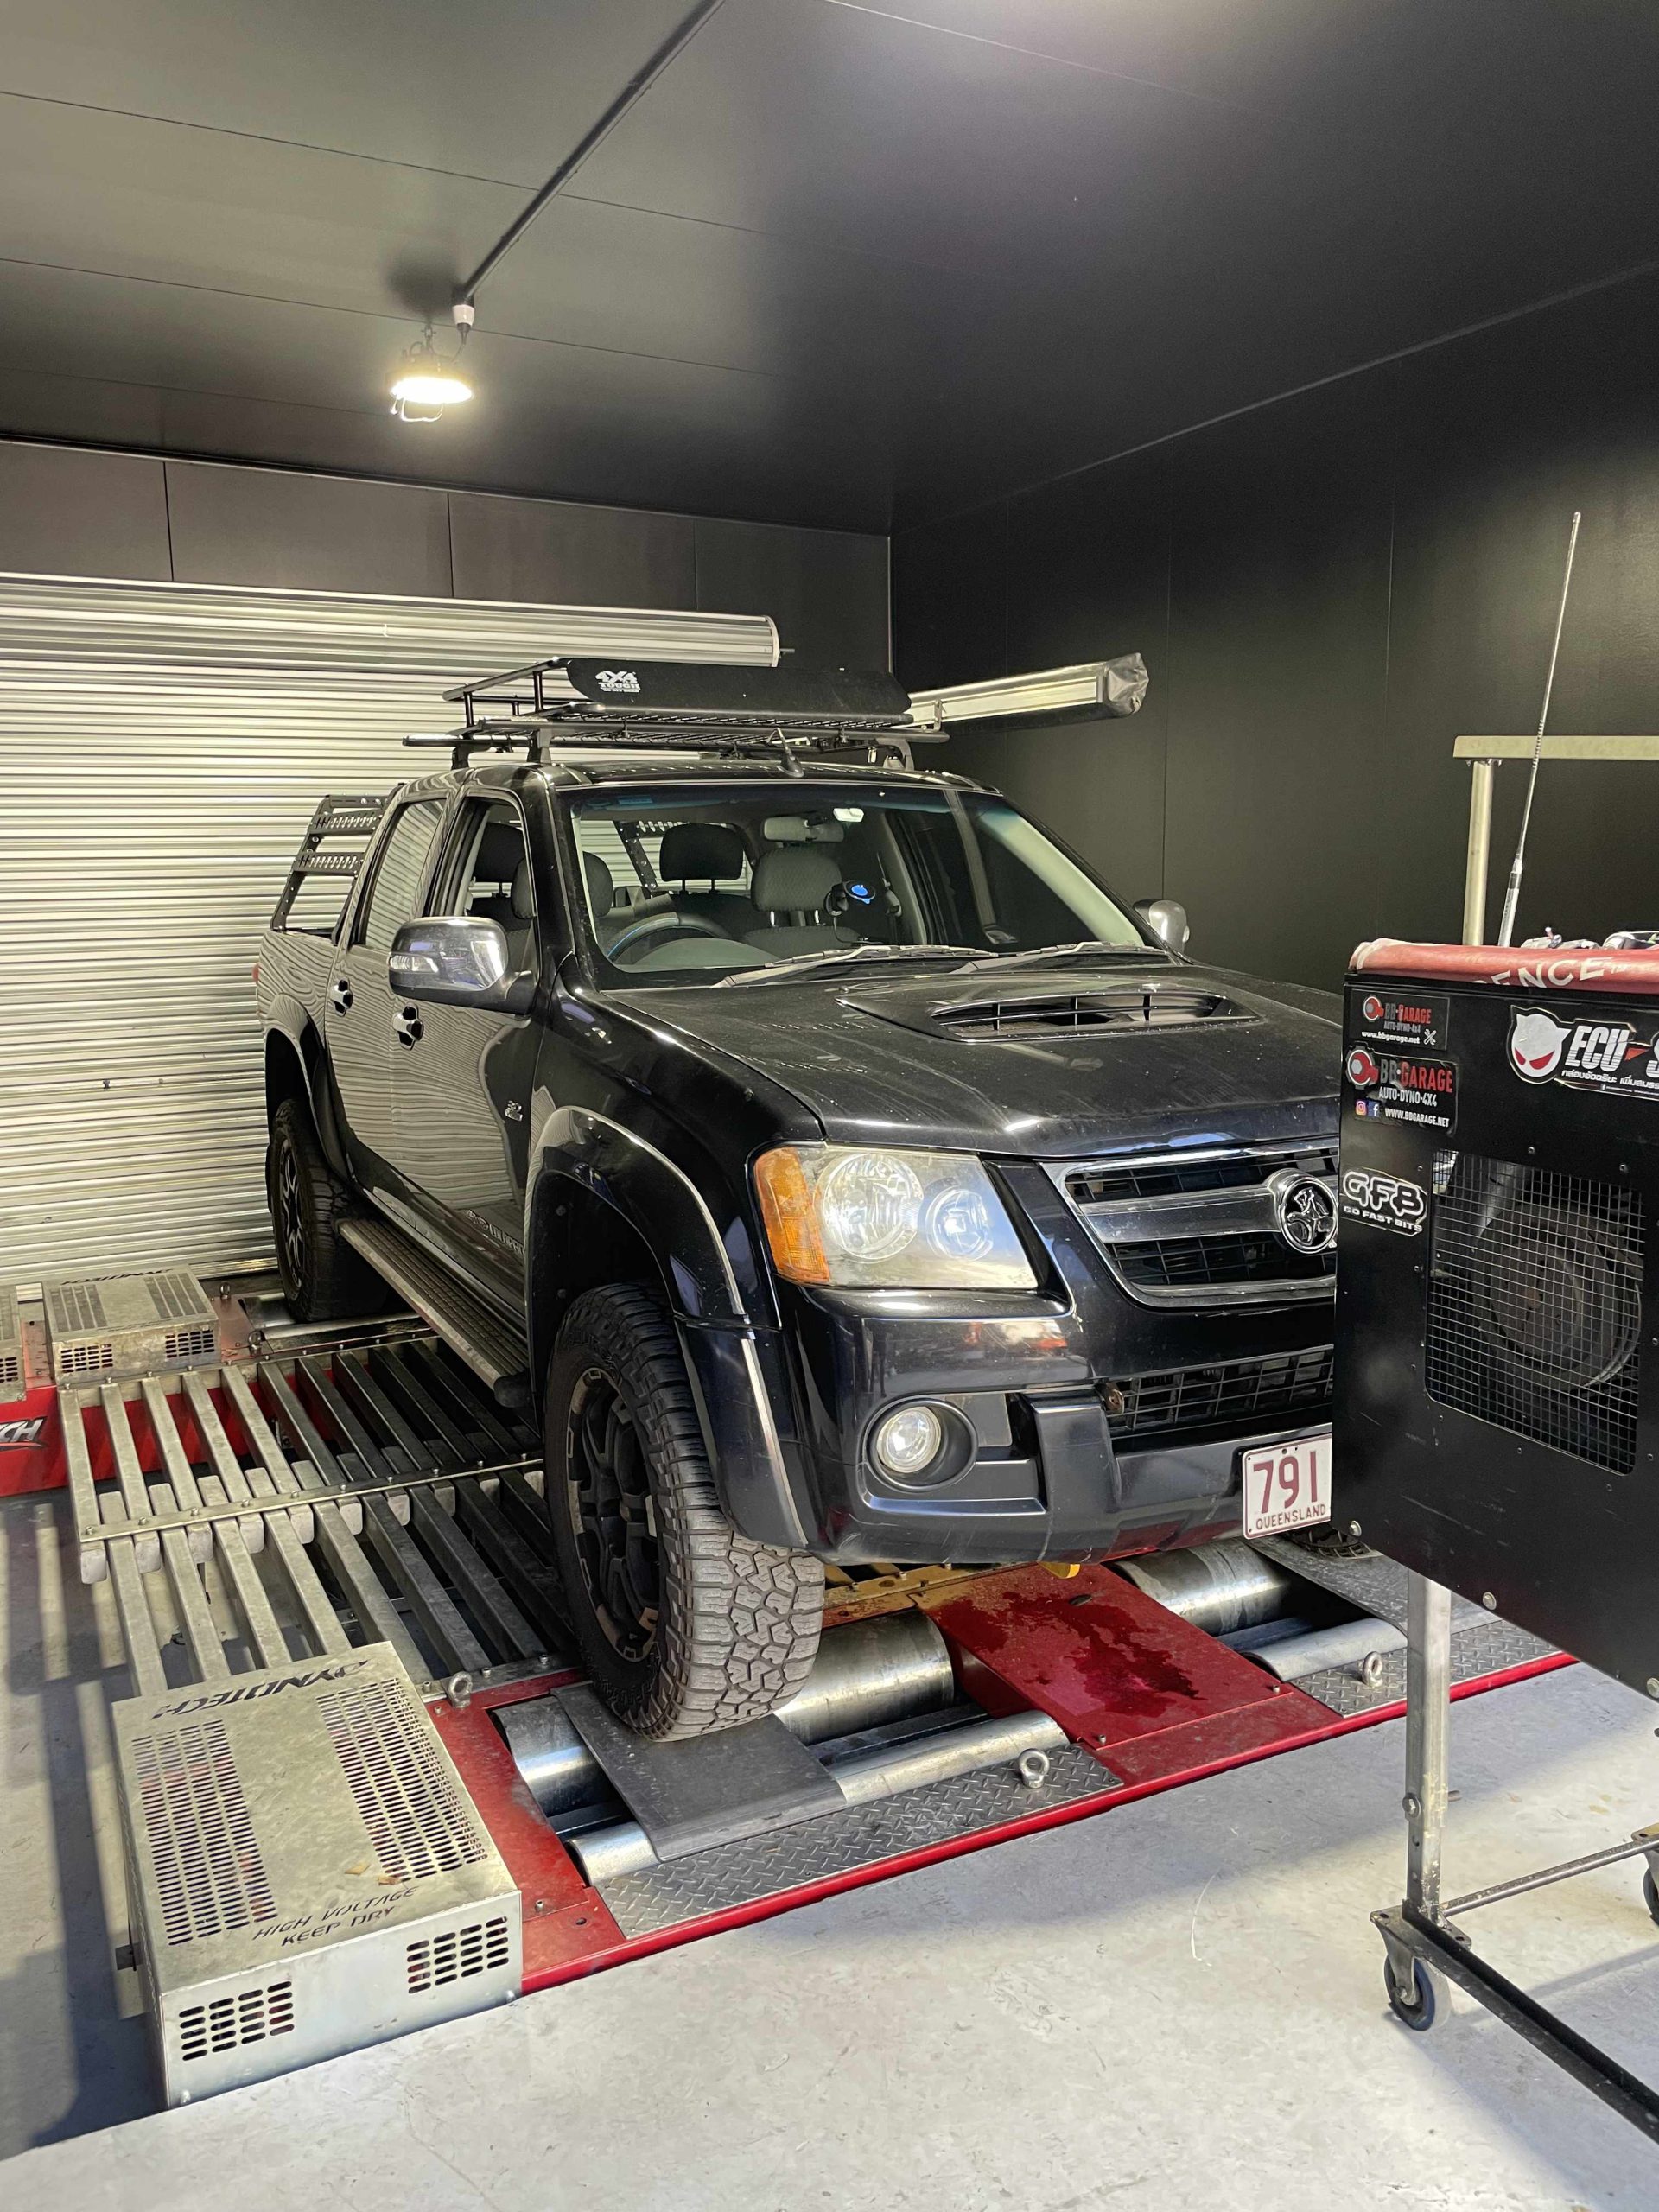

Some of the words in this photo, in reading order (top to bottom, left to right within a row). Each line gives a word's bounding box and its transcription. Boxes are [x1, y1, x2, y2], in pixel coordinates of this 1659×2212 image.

[1362, 1032, 1420, 1044] www.bbgarage.net
[1565, 1026, 1630, 1071] ECU
[1384, 1108, 1450, 1127] WWW.BBGARAGE.NET
[1343, 1171, 1424, 1217] GFB
[1344, 1206, 1360, 1215] GO
[1362, 1211, 1393, 1224] FAST
[1394, 1218, 1423, 1232] BITS
[1253, 1451, 1318, 1514] 791
[1255, 1503, 1326, 1530] QUEENSLAND
[252, 1915, 313, 1941] HIGH
[321, 1885, 420, 1921] VOLTAGE
[282, 1922, 341, 1946] KEEP
[351, 1905, 395, 1927] DRY
